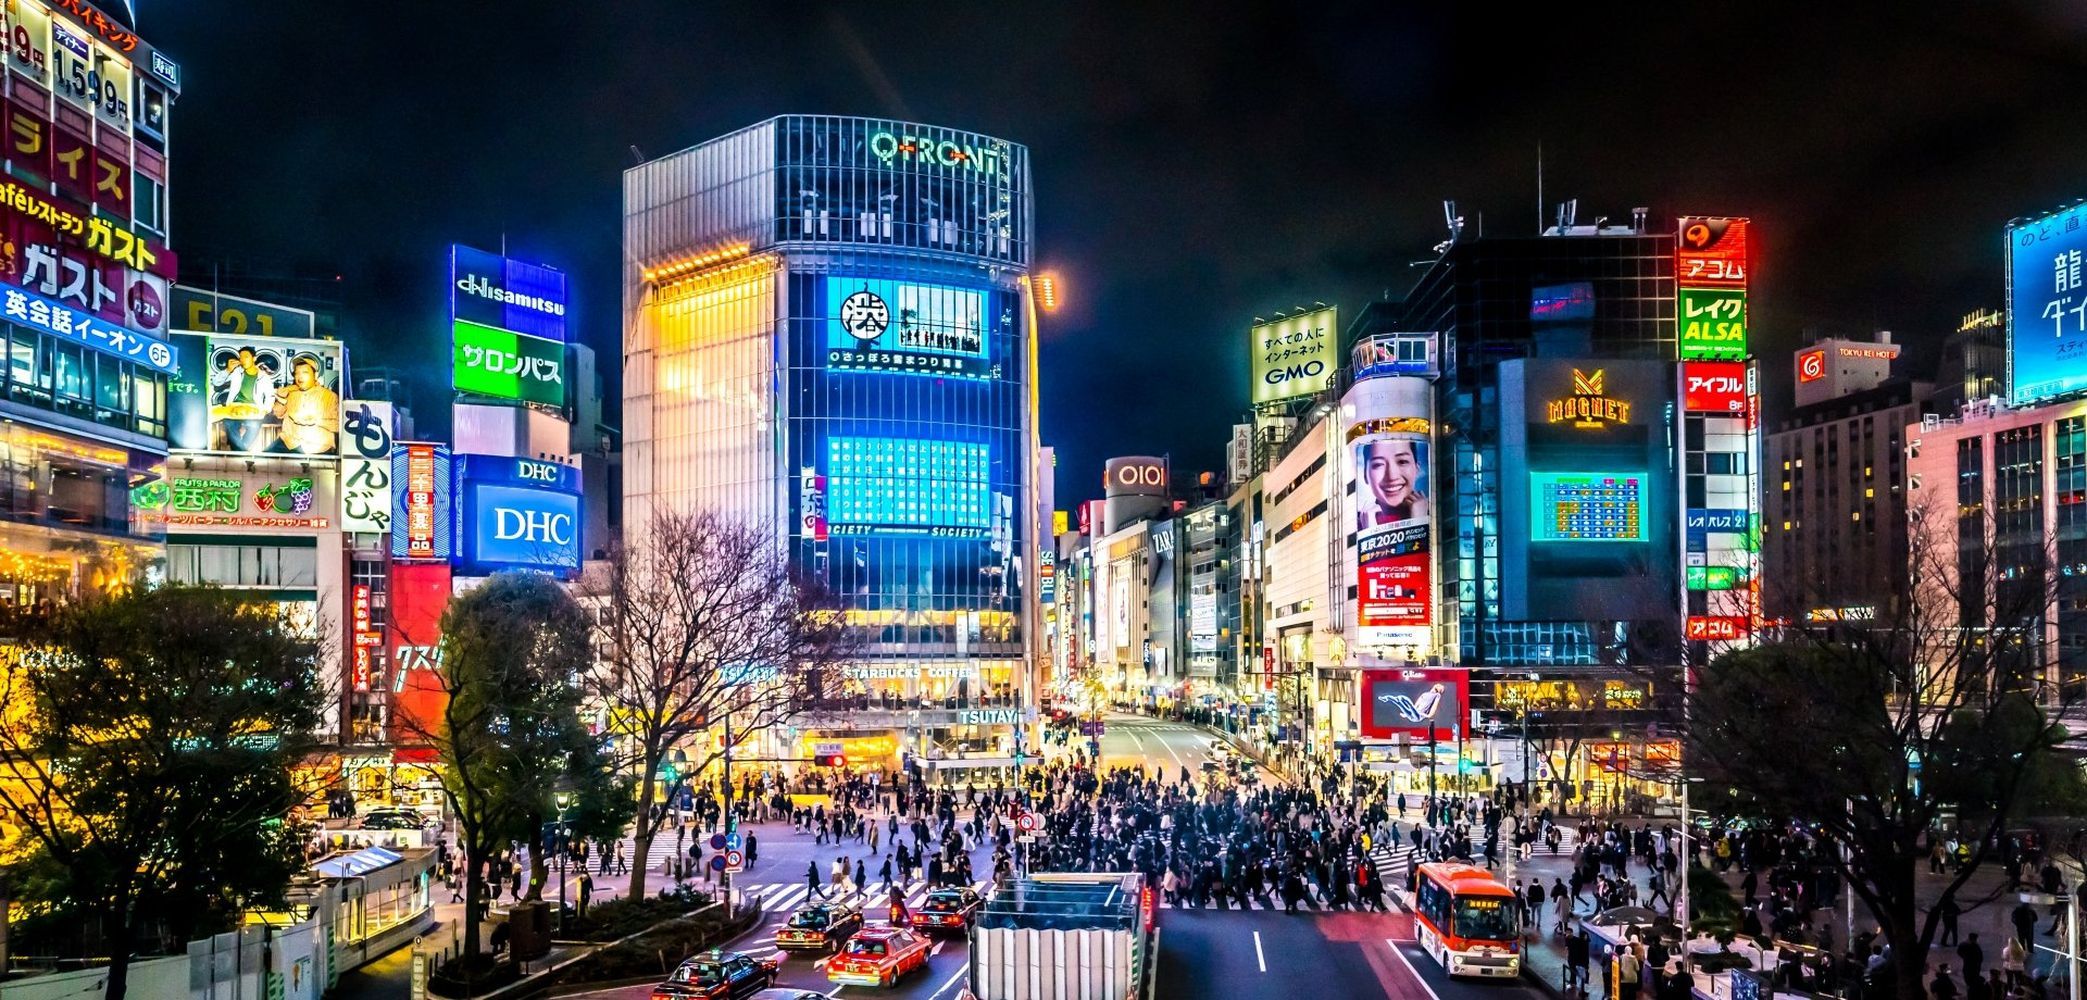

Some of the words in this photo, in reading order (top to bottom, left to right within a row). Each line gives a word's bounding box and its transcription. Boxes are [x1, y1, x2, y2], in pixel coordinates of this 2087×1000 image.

[55, 26, 87, 52] ディナー
[871, 132, 998, 175] QFRONT
[88, 216, 156, 271] ガスト
[22, 243, 116, 312] ガスト
[1687, 259, 1743, 279] アコム
[457, 274, 564, 316] Hisamitsu
[1686, 298, 1742, 319] レイク
[6, 290, 144, 355] 英会話イーオン
[151, 346, 168, 363] 6F
[1684, 321, 1743, 341] ALSA
[1265, 328, 1324, 350] すべての人に
[463, 344, 561, 384] サロンパス
[1265, 342, 1324, 363] インターネット
[1840, 348, 1863, 358] TOKYU
[1876, 351, 1897, 359] HOTEL
[1265, 360, 1324, 384] GMO
[1688, 377, 1742, 393] アイフル
[1549, 397, 1632, 423] MAGNET
[1728, 401, 1743, 411] 8F
[344, 404, 391, 529] もんじゃ
[518, 460, 557, 482] DHC
[174, 489, 241, 513] 西村
[494, 507, 571, 545] DHC
[931, 526, 983, 538] SOCIETY
[1693, 621, 1733, 635] アコム
[843, 668, 921, 679] STARBUCKS
